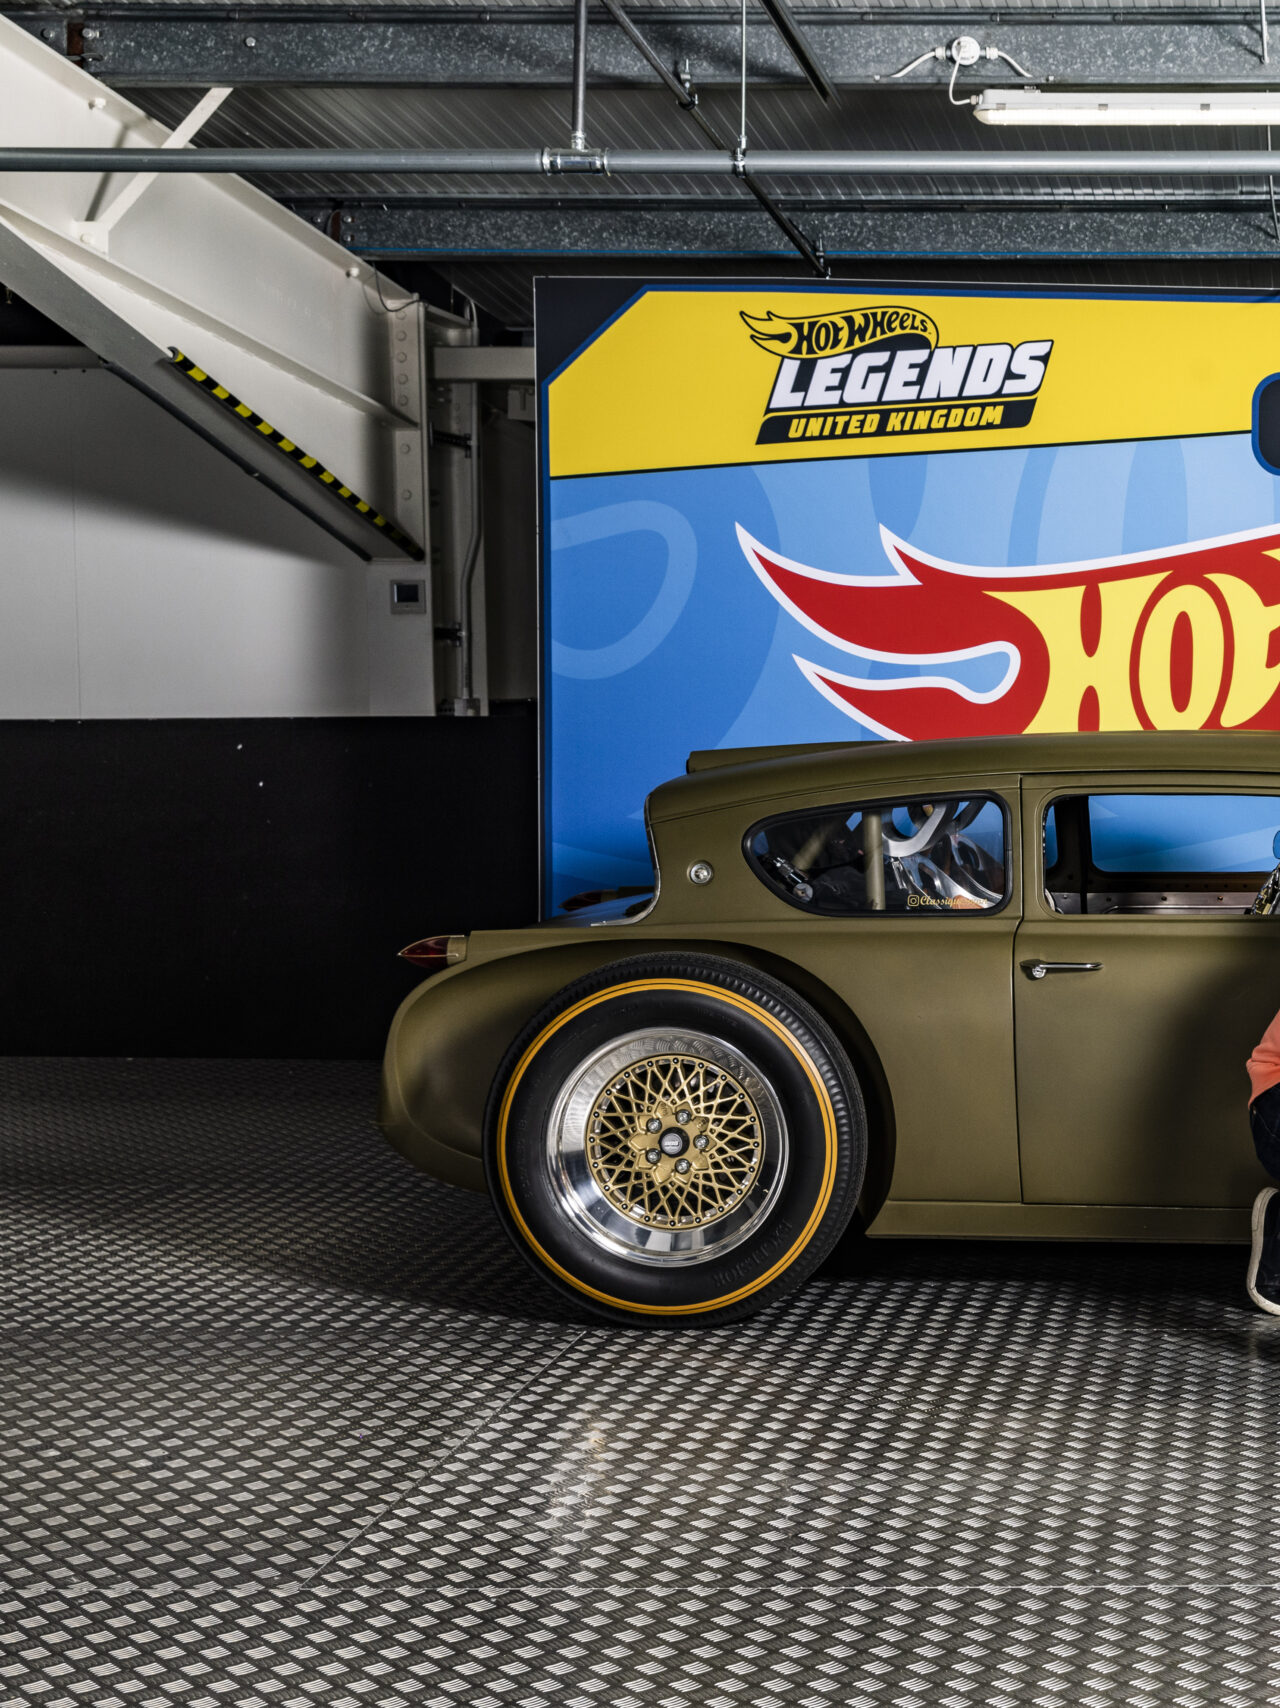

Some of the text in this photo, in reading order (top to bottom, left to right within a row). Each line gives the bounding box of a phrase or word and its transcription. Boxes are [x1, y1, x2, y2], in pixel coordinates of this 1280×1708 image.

[769, 341, 1053, 409] LEGENDS
[788, 405, 1004, 439] UNITED KINGDOM
